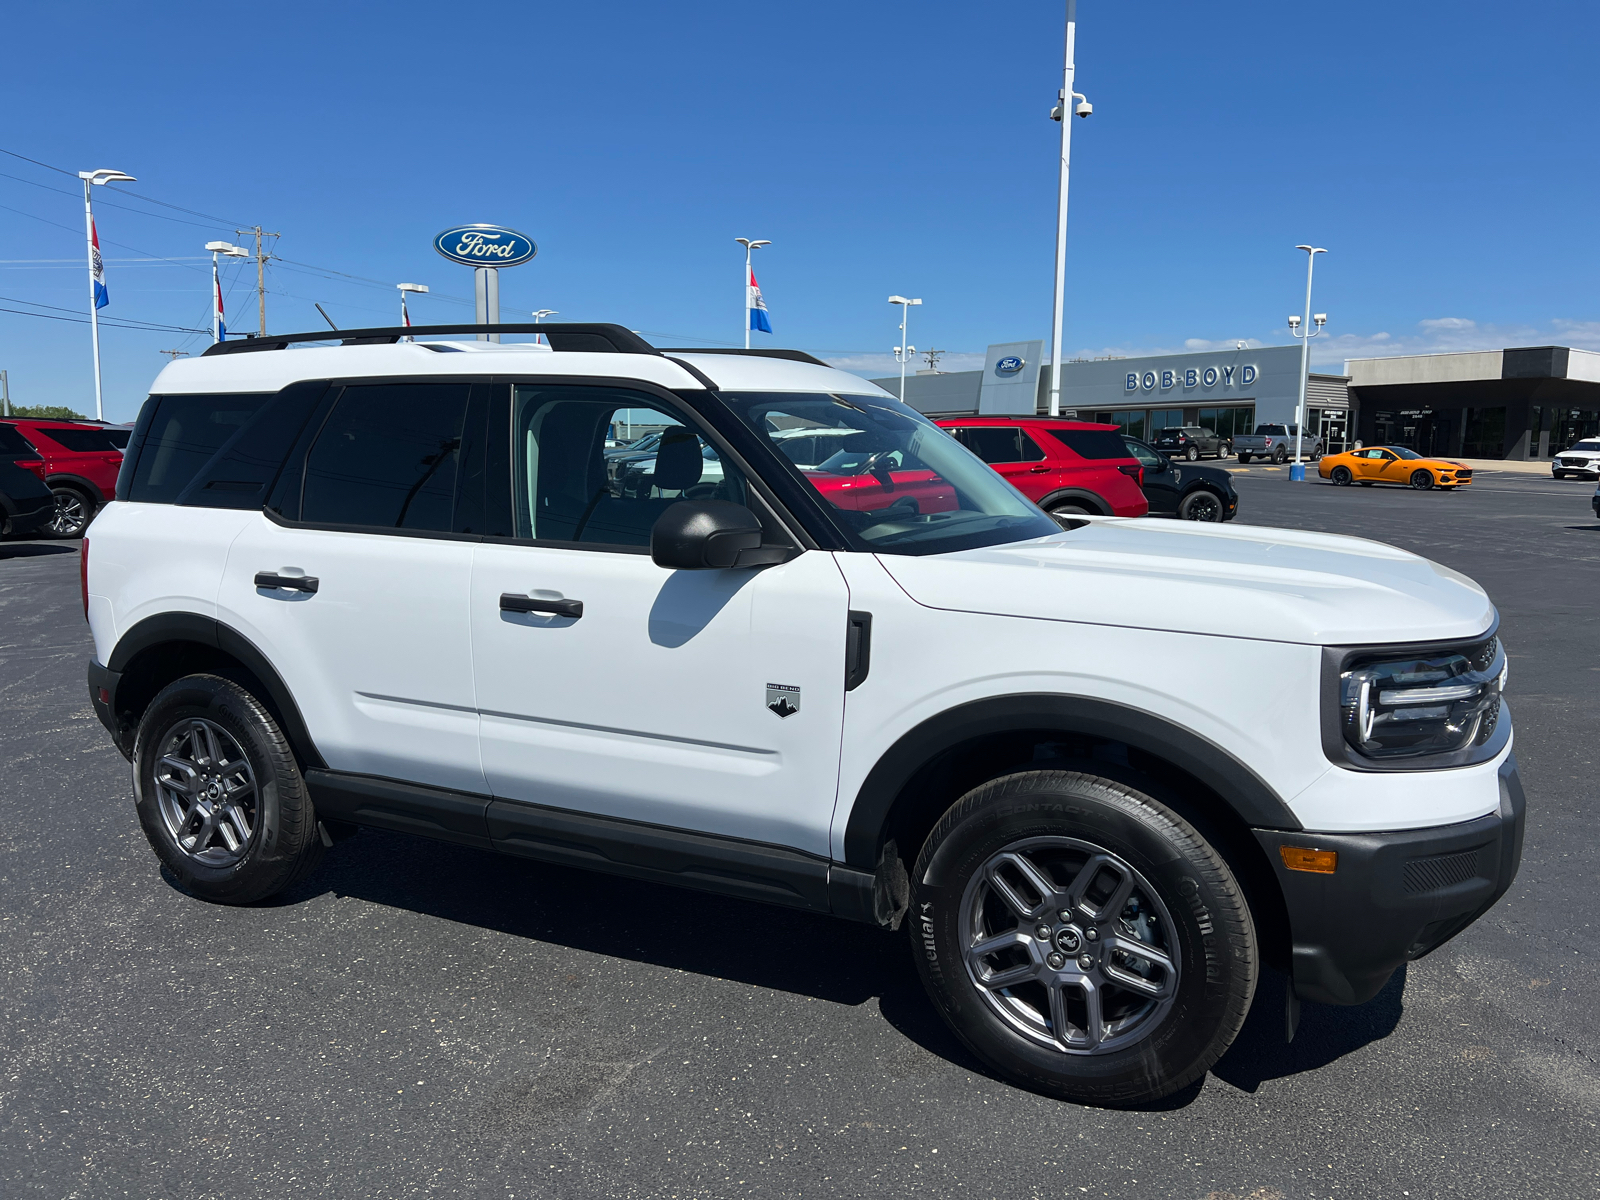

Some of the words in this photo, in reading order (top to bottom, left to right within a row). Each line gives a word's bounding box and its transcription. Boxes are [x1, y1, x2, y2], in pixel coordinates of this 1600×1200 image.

[456, 232, 516, 257] Ford
[1001, 359, 1016, 369] Ford
[1125, 365, 1258, 390] BOB-BOYD
